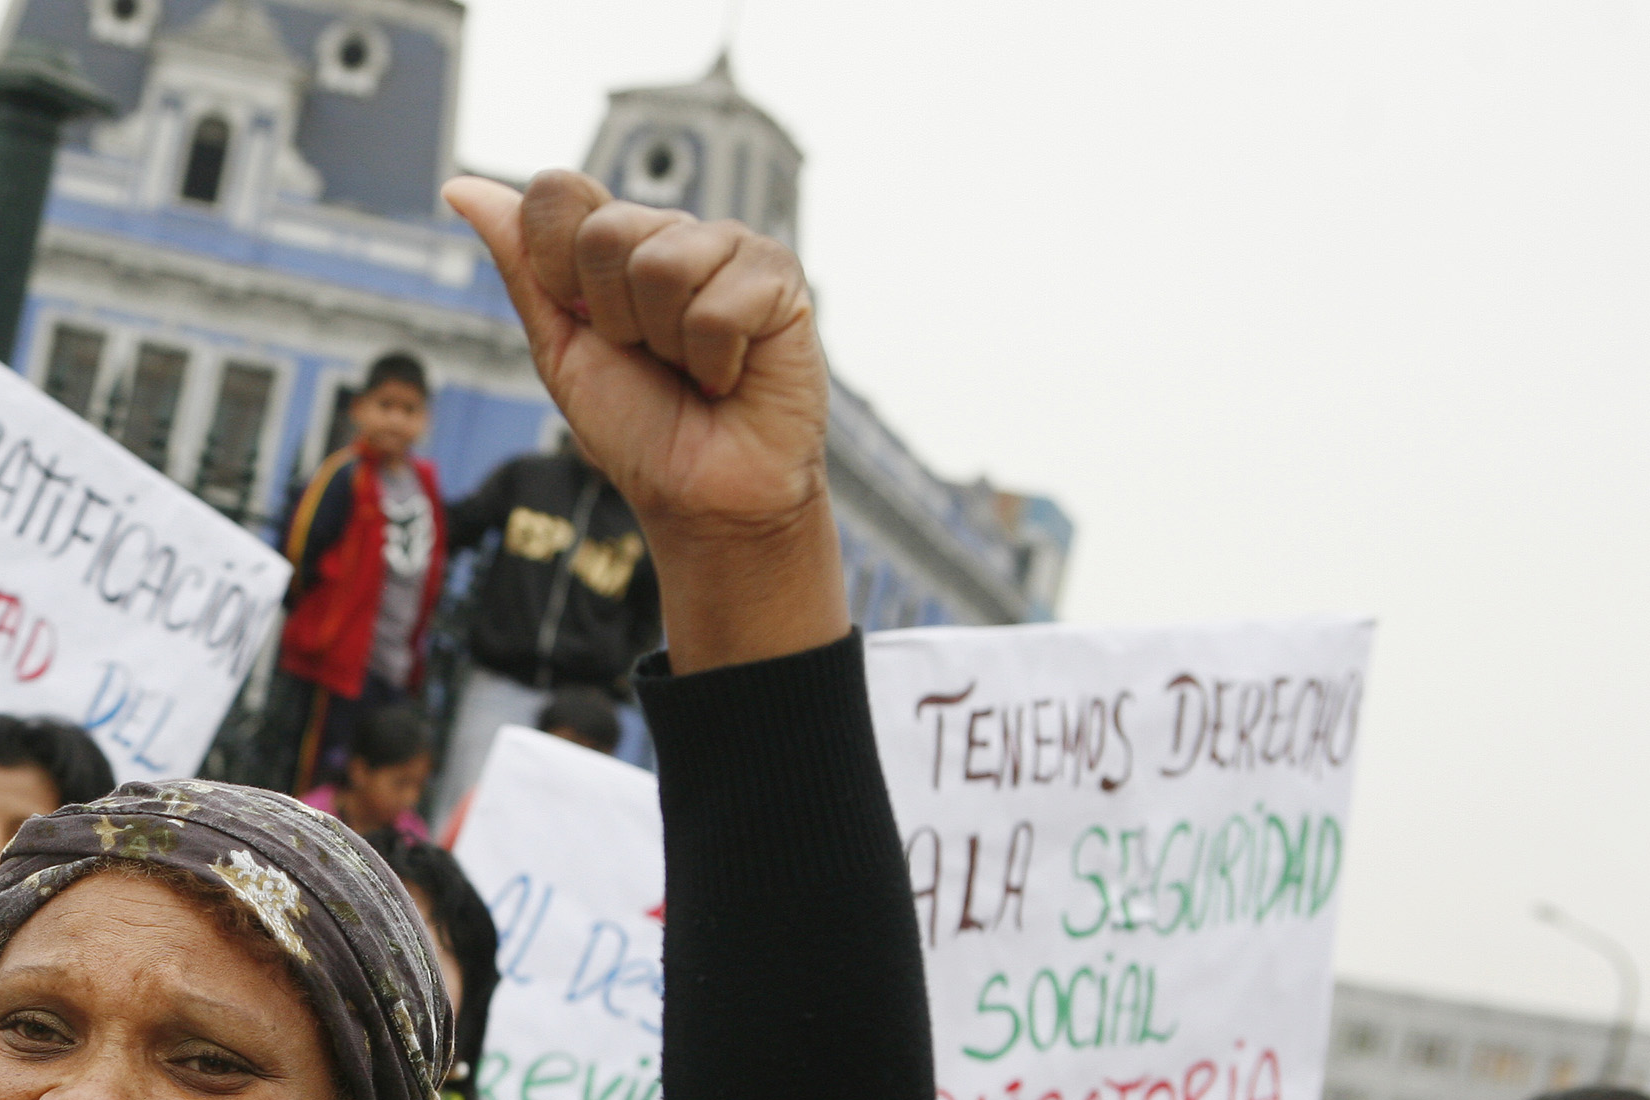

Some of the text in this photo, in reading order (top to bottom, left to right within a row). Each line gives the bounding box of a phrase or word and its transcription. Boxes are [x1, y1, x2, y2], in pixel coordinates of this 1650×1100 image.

[83, 660, 178, 773] DEL
[917, 670, 1363, 792] TENEMOS DERECHO
[1062, 800, 1344, 939] SEGURIDAD
